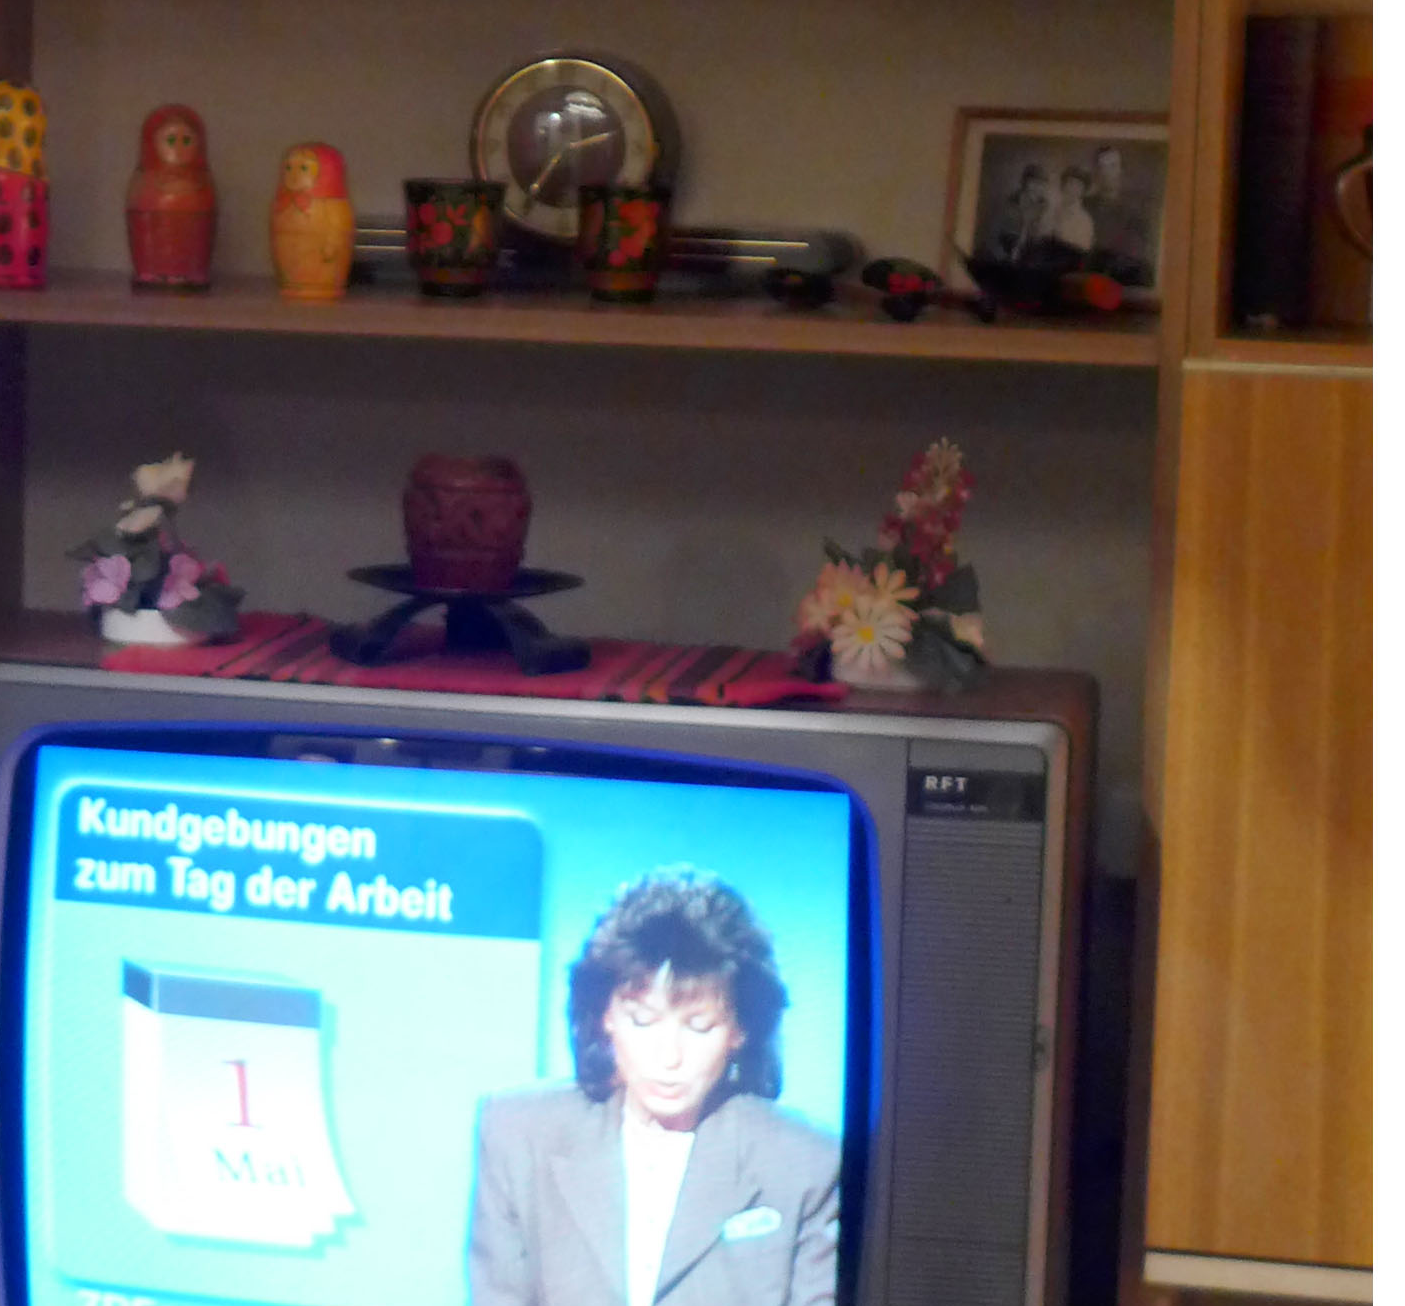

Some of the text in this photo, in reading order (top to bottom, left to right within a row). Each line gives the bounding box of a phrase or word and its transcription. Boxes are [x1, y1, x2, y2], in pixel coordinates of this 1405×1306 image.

[924, 775, 968, 792] RFT
[78, 796, 377, 865] Kundgebungen
[74, 855, 454, 923] zum Tag der Arbeit
[221, 1058, 264, 1129] 1
[212, 1146, 307, 1189] Mai
